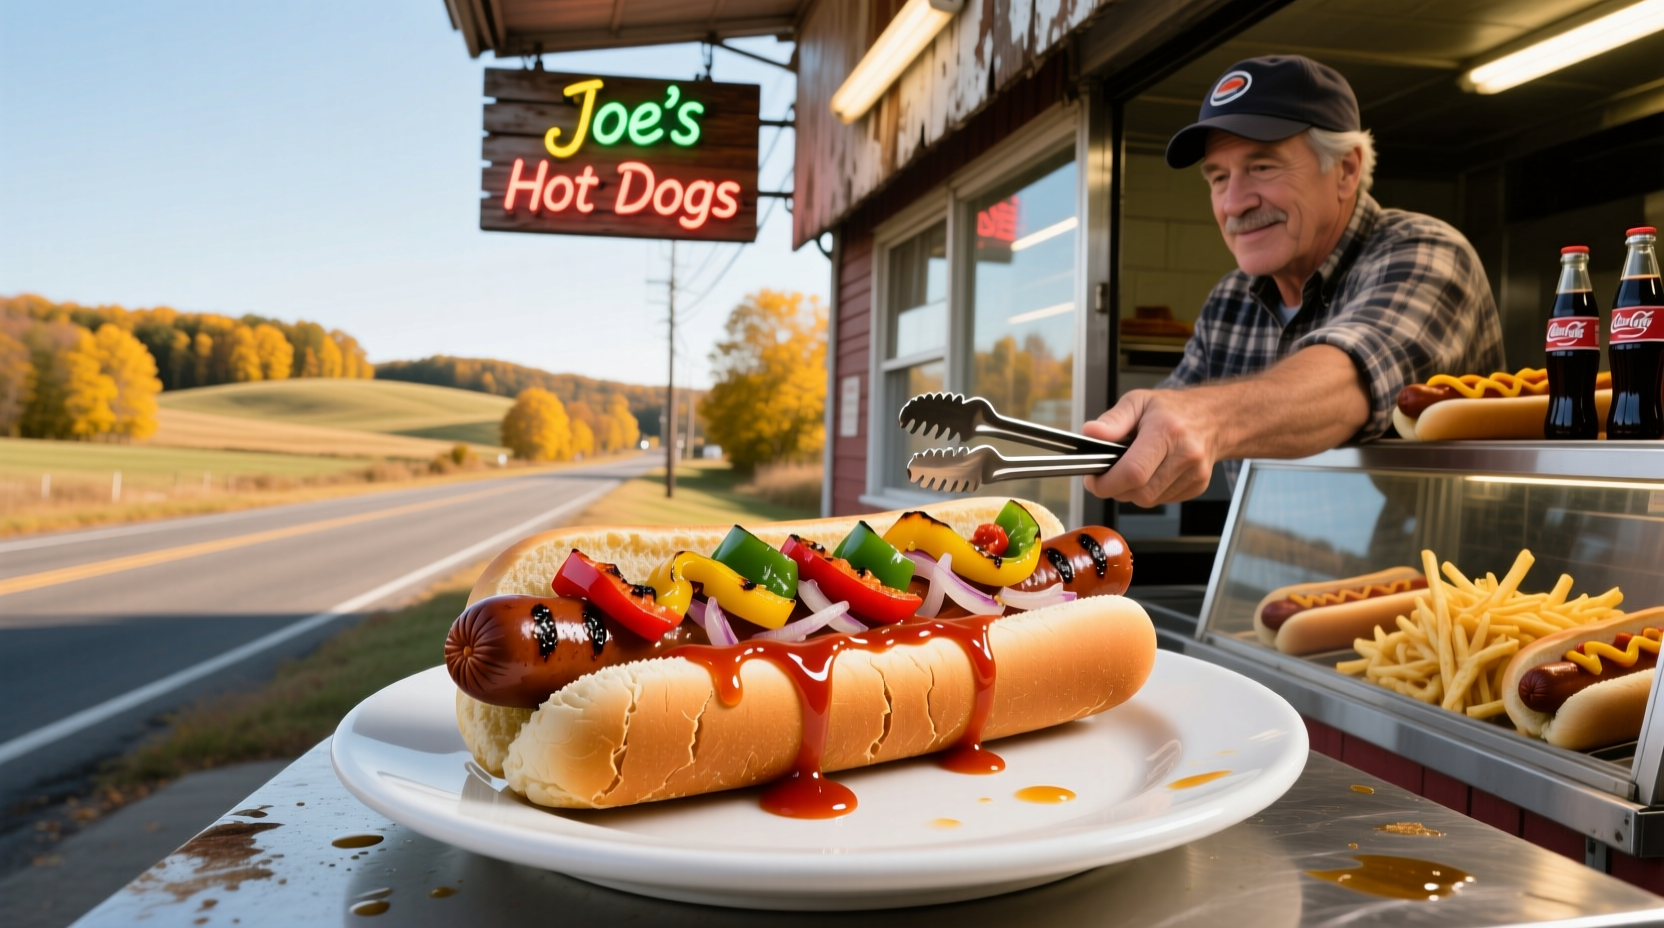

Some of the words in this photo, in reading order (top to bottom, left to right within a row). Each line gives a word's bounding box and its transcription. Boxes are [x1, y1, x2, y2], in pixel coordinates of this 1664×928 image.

[544, 79, 704, 159] Joe's
[503, 158, 599, 213] Hot
[614, 161, 741, 230] Dogs
